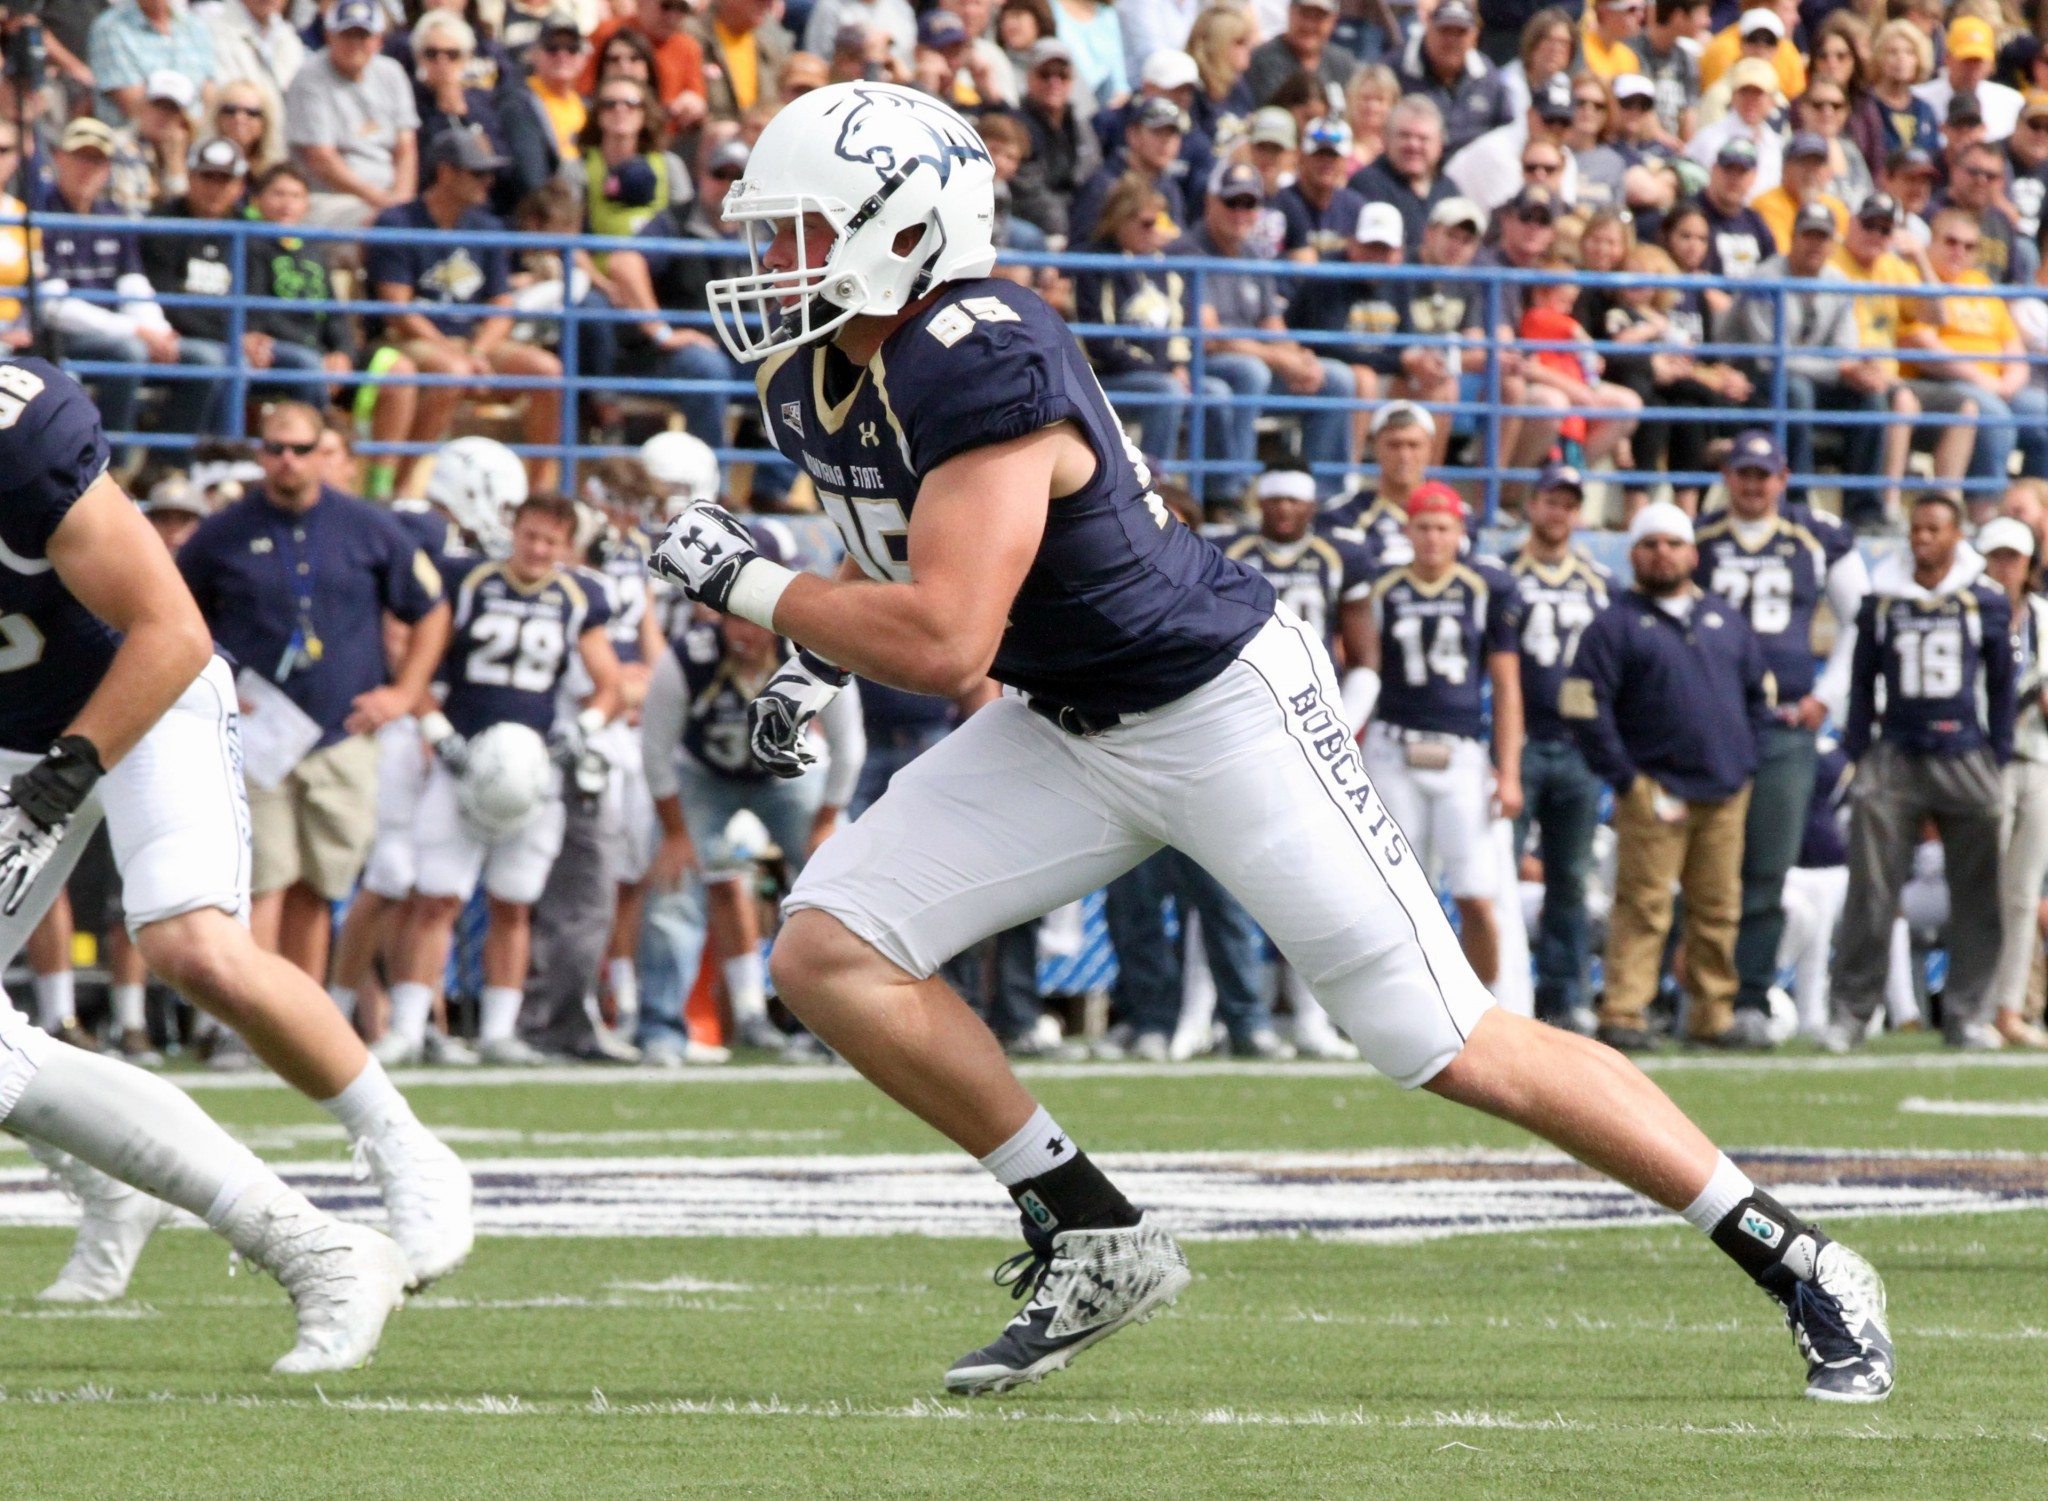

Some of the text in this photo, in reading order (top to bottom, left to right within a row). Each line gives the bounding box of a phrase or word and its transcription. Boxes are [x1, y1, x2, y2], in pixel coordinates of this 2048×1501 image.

[925, 295, 1022, 349] 85
[849, 465, 884, 489] STATE
[465, 613, 564, 694] 28
[1392, 615, 1469, 687] 14
[1521, 602, 1595, 668] 47
[1289, 683, 1407, 867] BOBCATS
